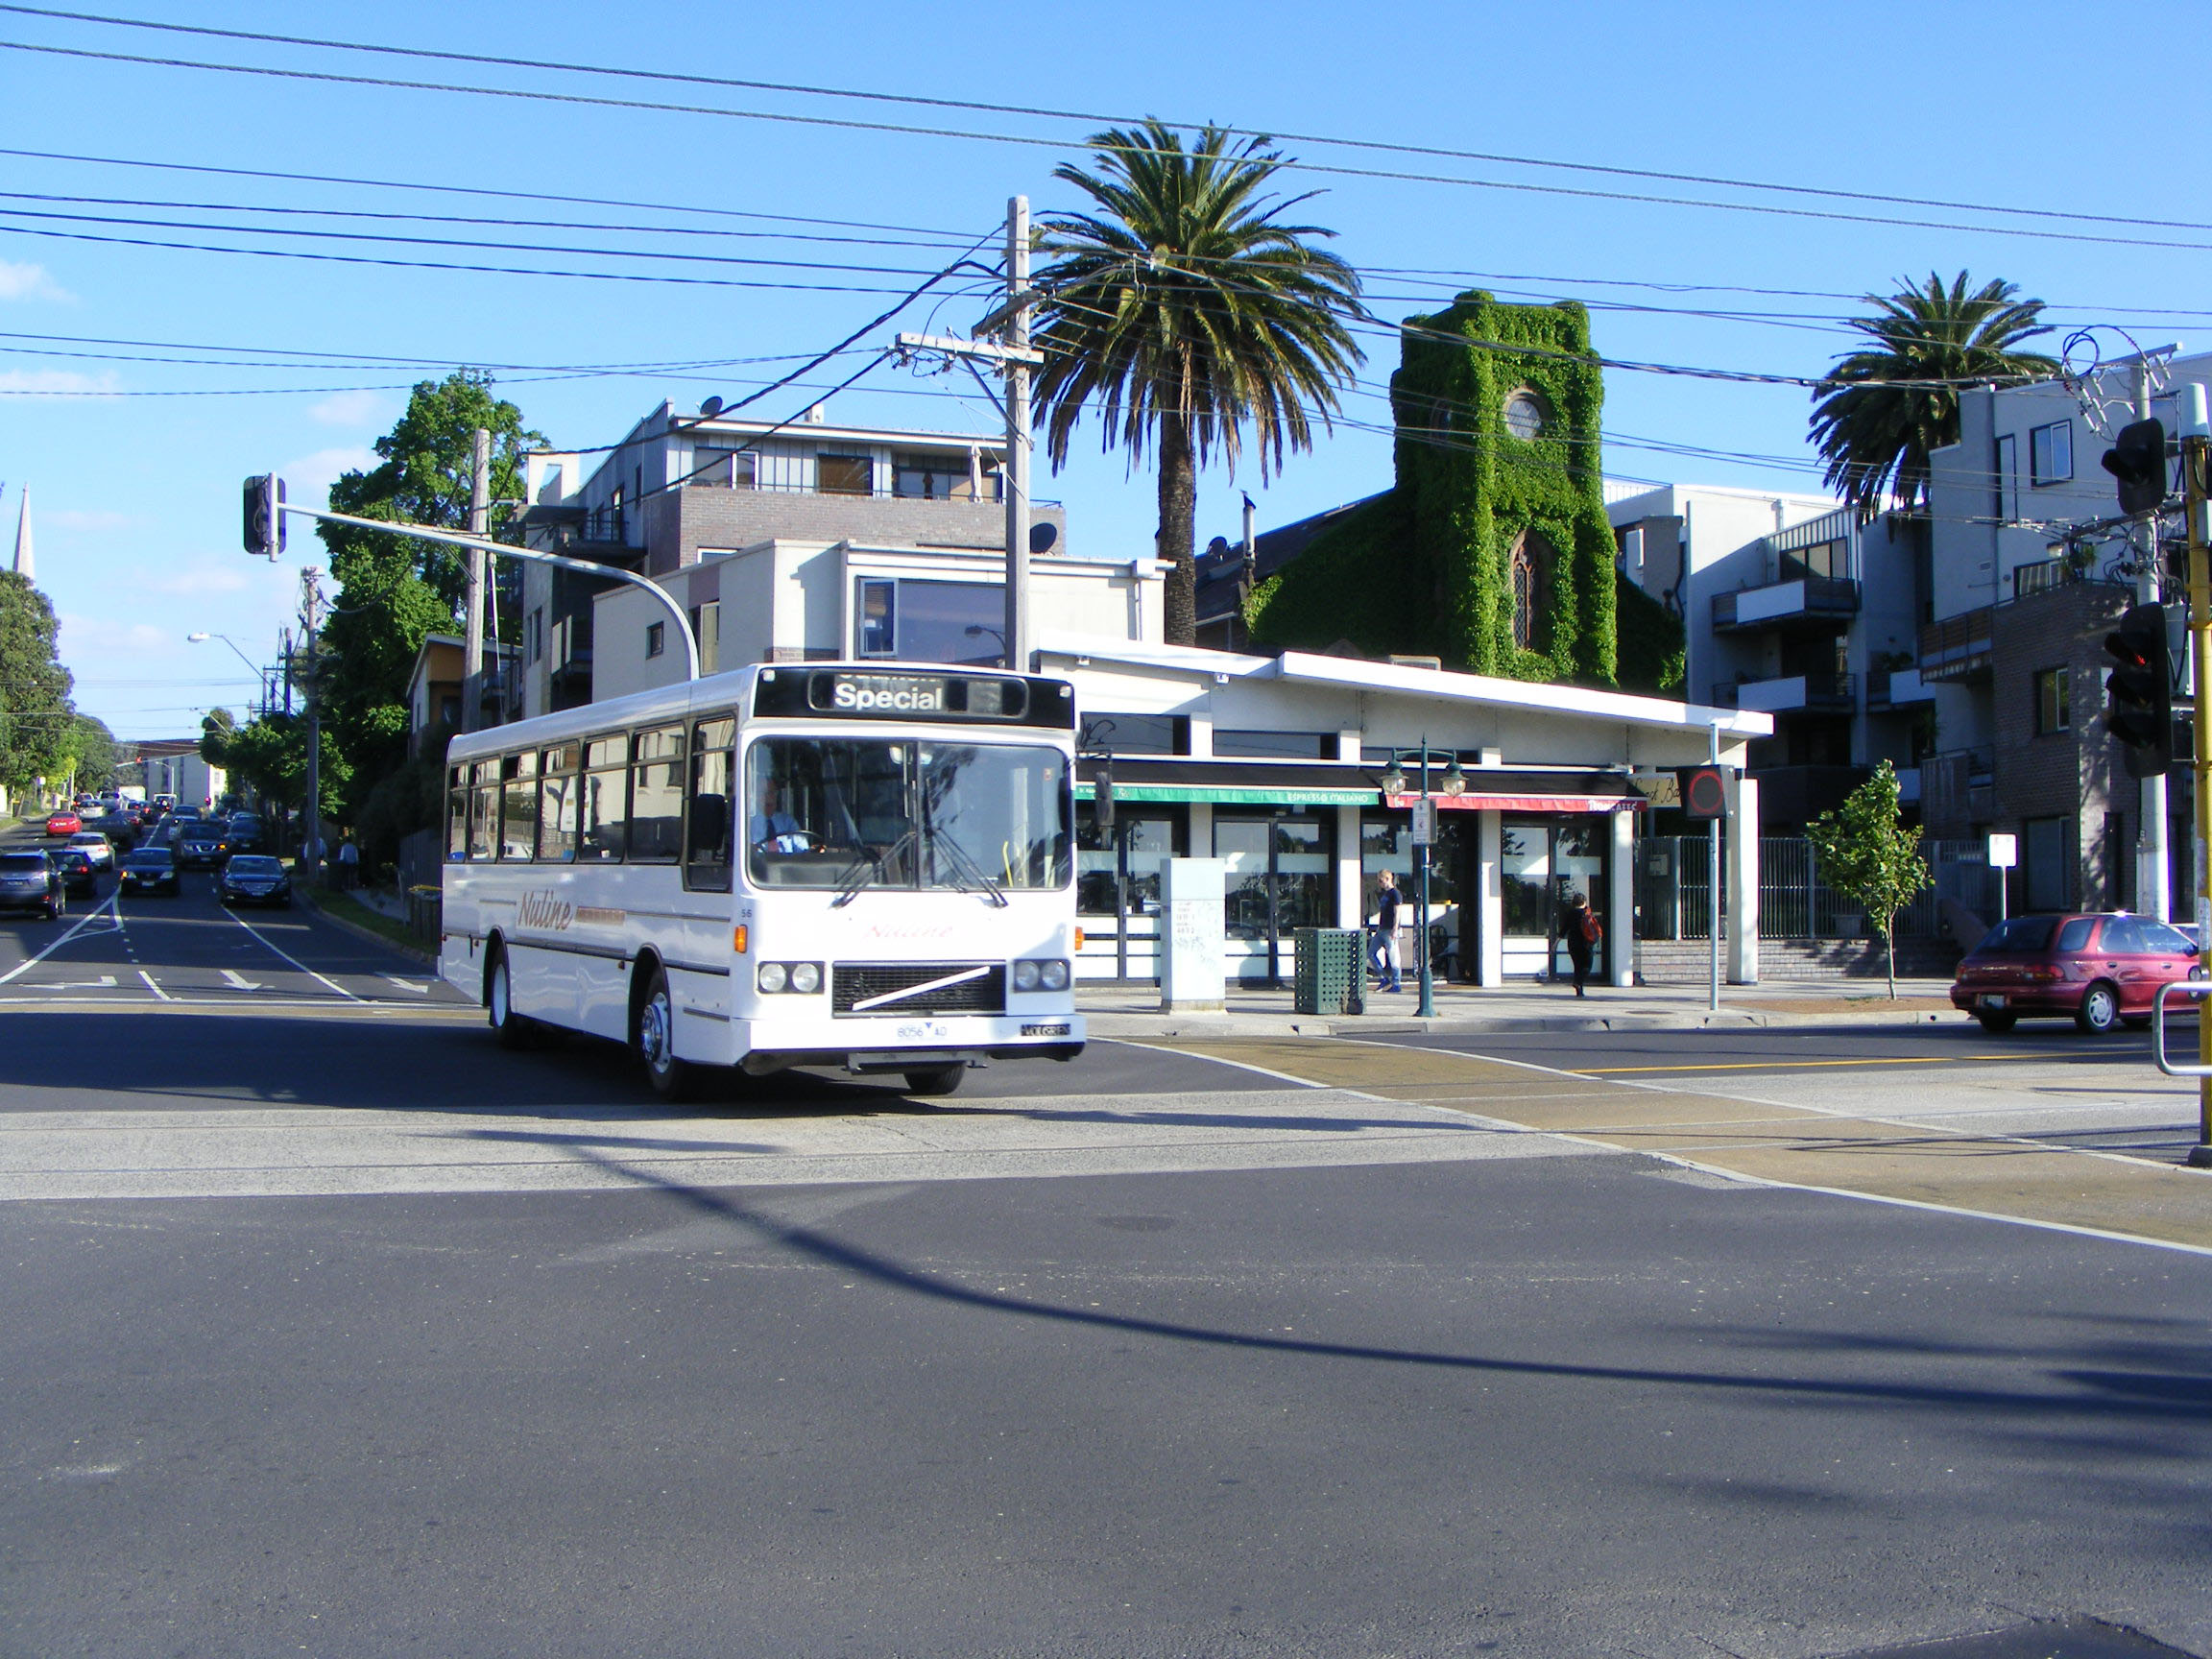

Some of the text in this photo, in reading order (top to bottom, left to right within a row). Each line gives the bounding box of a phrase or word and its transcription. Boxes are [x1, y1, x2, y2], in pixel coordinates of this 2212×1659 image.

[835, 683, 942, 710] Special
[1287, 792, 1369, 804] ESPRESSO ITALIANO
[1660, 776, 1681, 804] Ba
[518, 889, 573, 930] Nuline
[897, 1026, 924, 1038] 8056
[1024, 1024, 1070, 1037] VOLGREN
